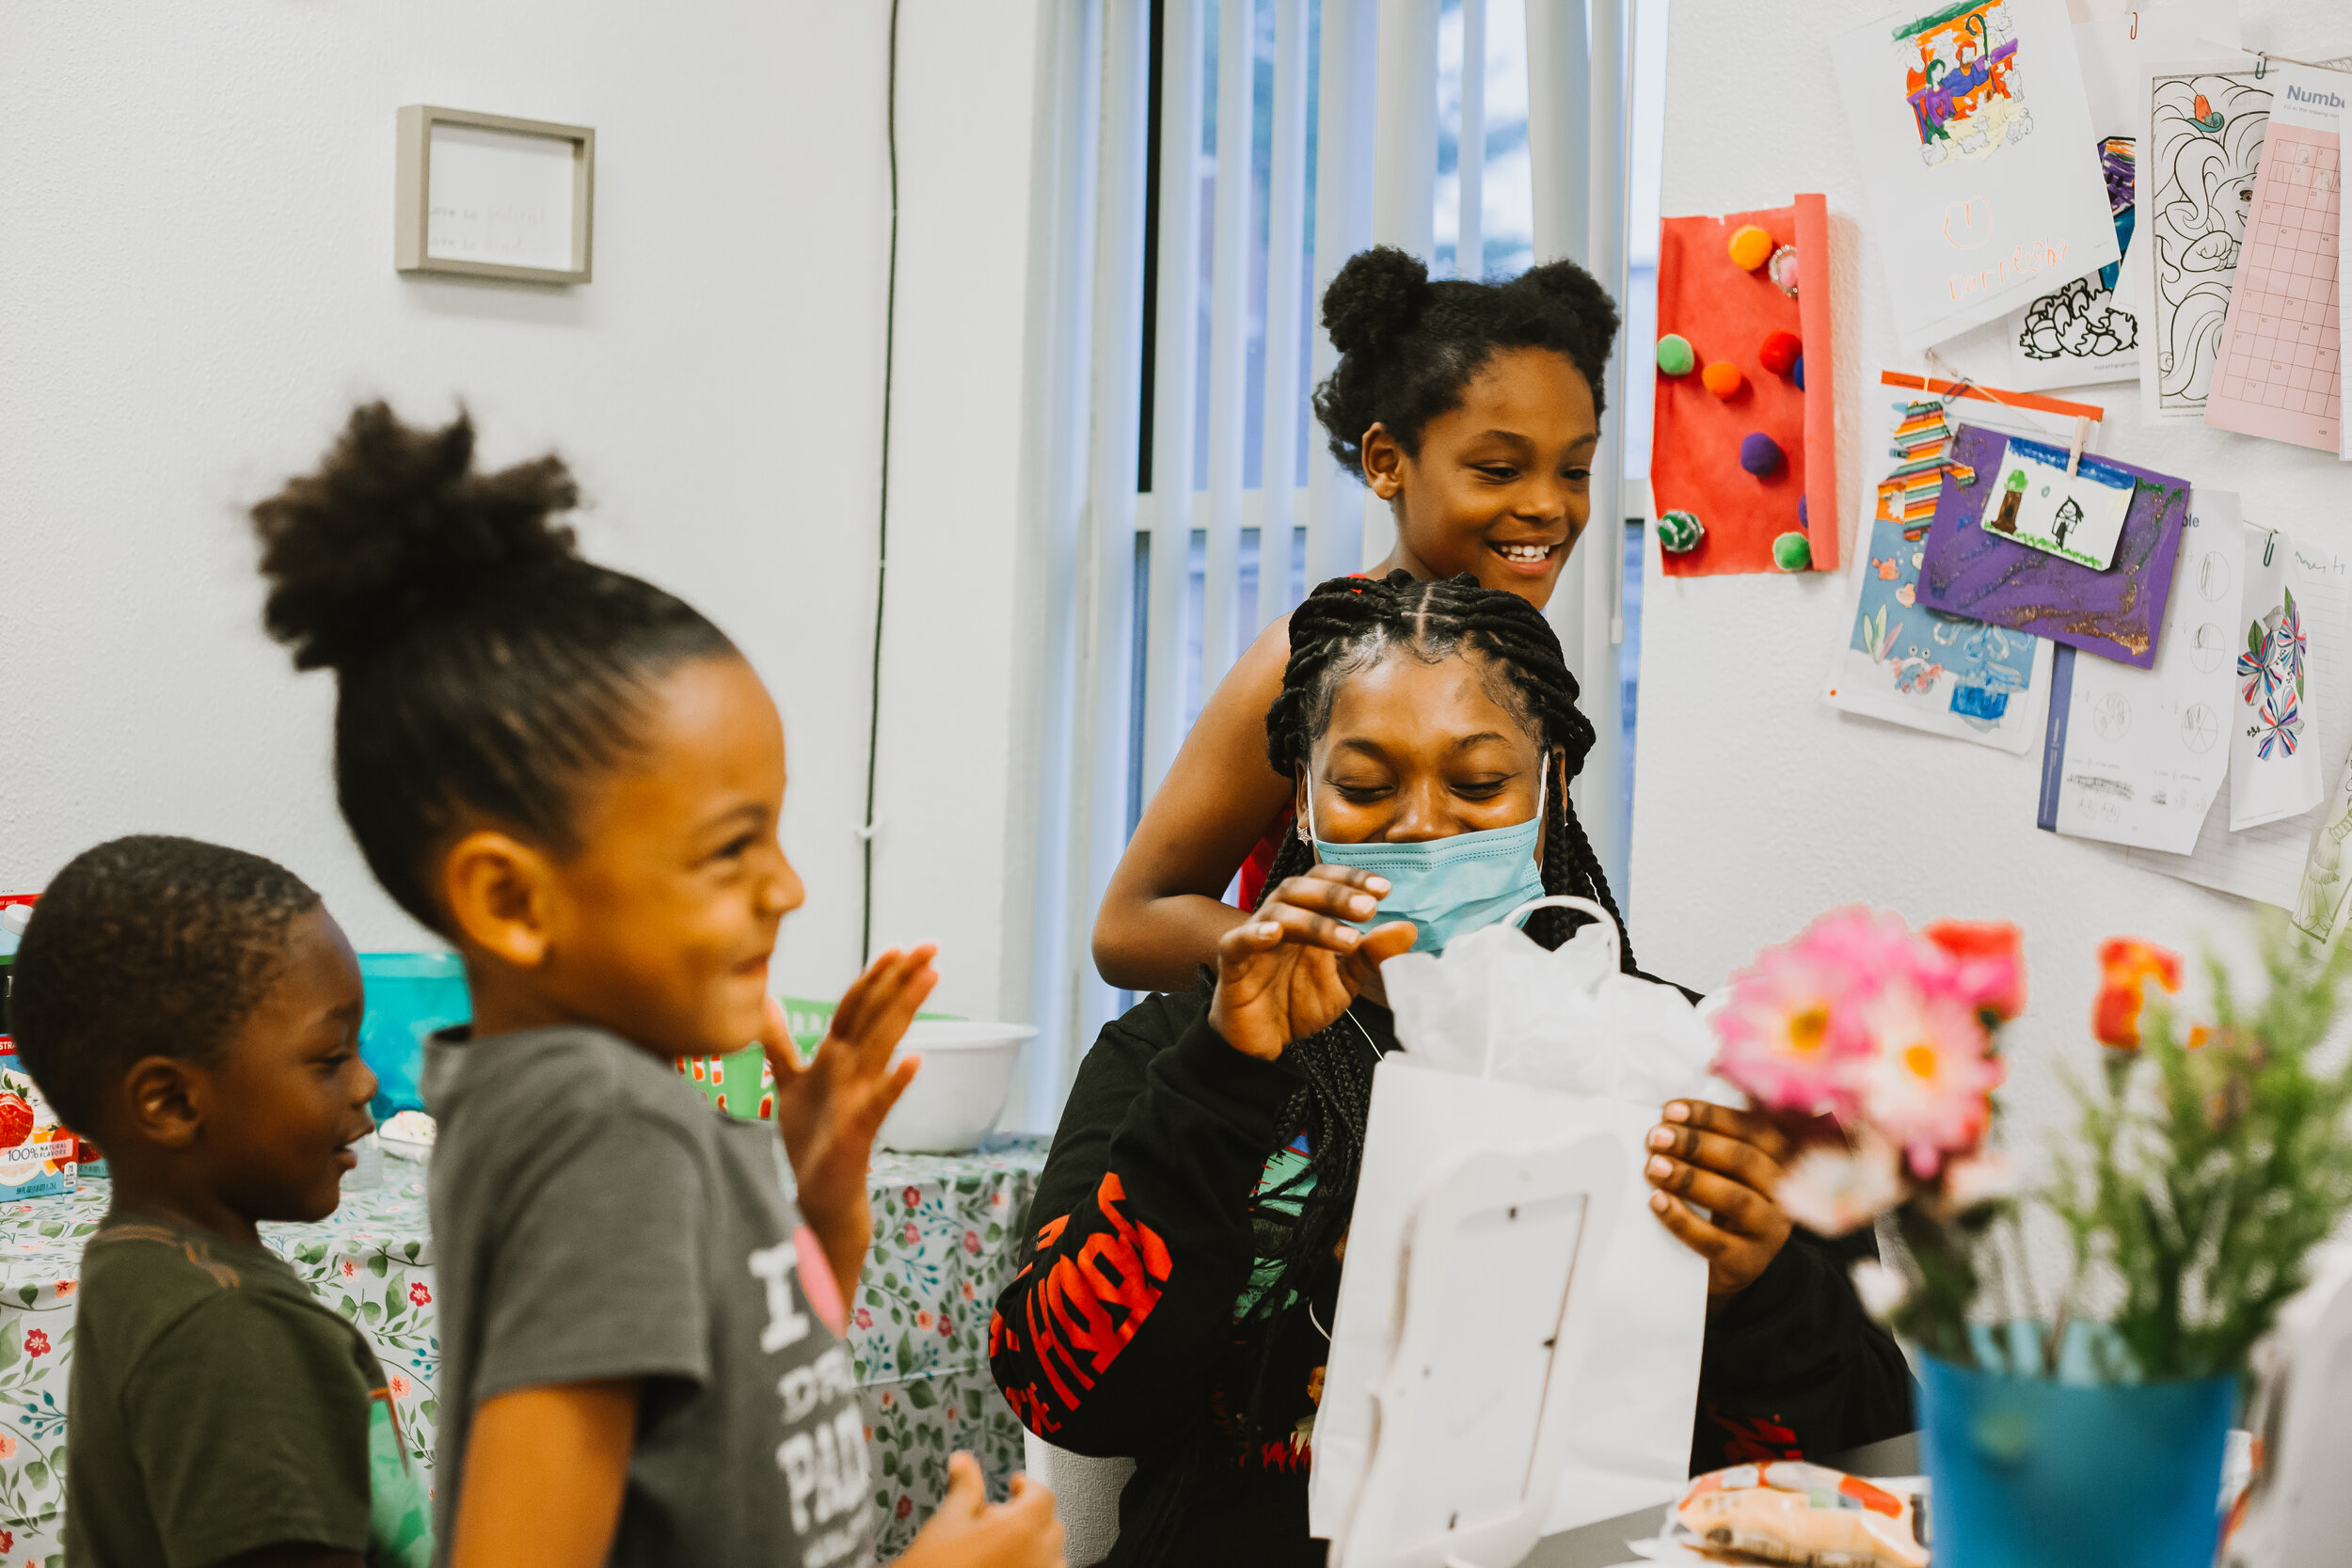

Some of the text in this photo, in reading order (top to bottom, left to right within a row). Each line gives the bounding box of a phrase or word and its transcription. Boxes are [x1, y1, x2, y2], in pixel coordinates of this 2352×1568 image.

[8, 1143, 67, 1163] 100% NATURAL
[40, 1148, 67, 1159] FLAVORS
